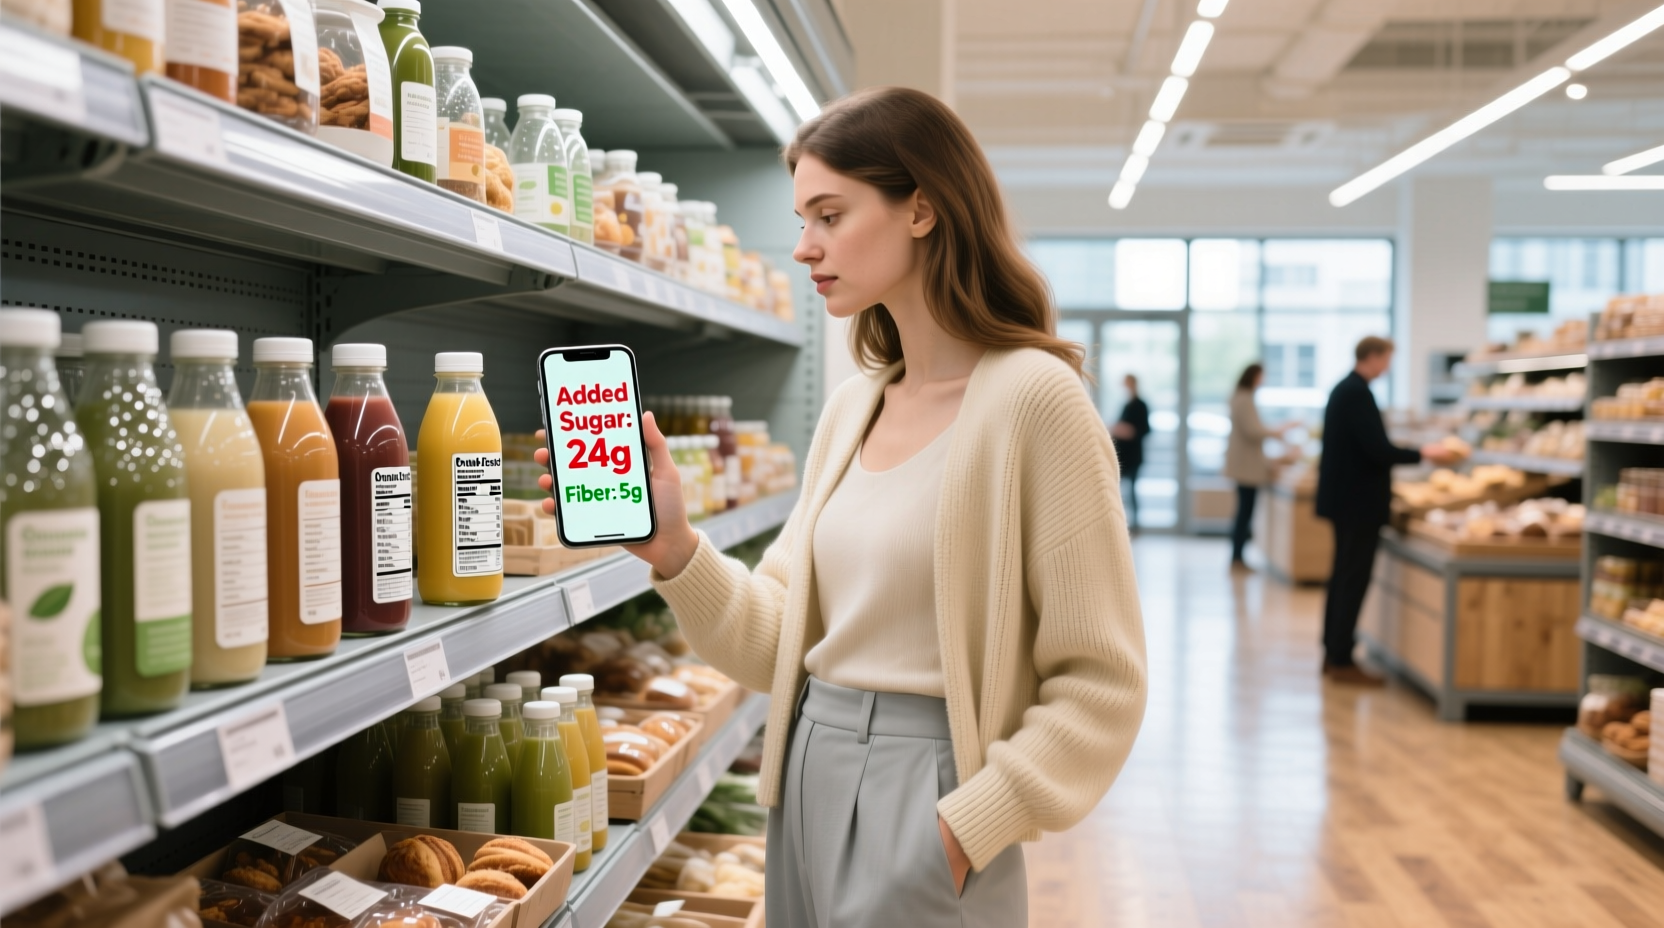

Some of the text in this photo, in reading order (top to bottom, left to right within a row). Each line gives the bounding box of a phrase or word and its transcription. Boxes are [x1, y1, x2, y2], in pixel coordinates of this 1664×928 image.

[557, 382, 628, 405] Added
[560, 411, 631, 435] Sugar:
[567, 438, 631, 475] 24g
[565, 482, 642, 503] Fiber: 5g
